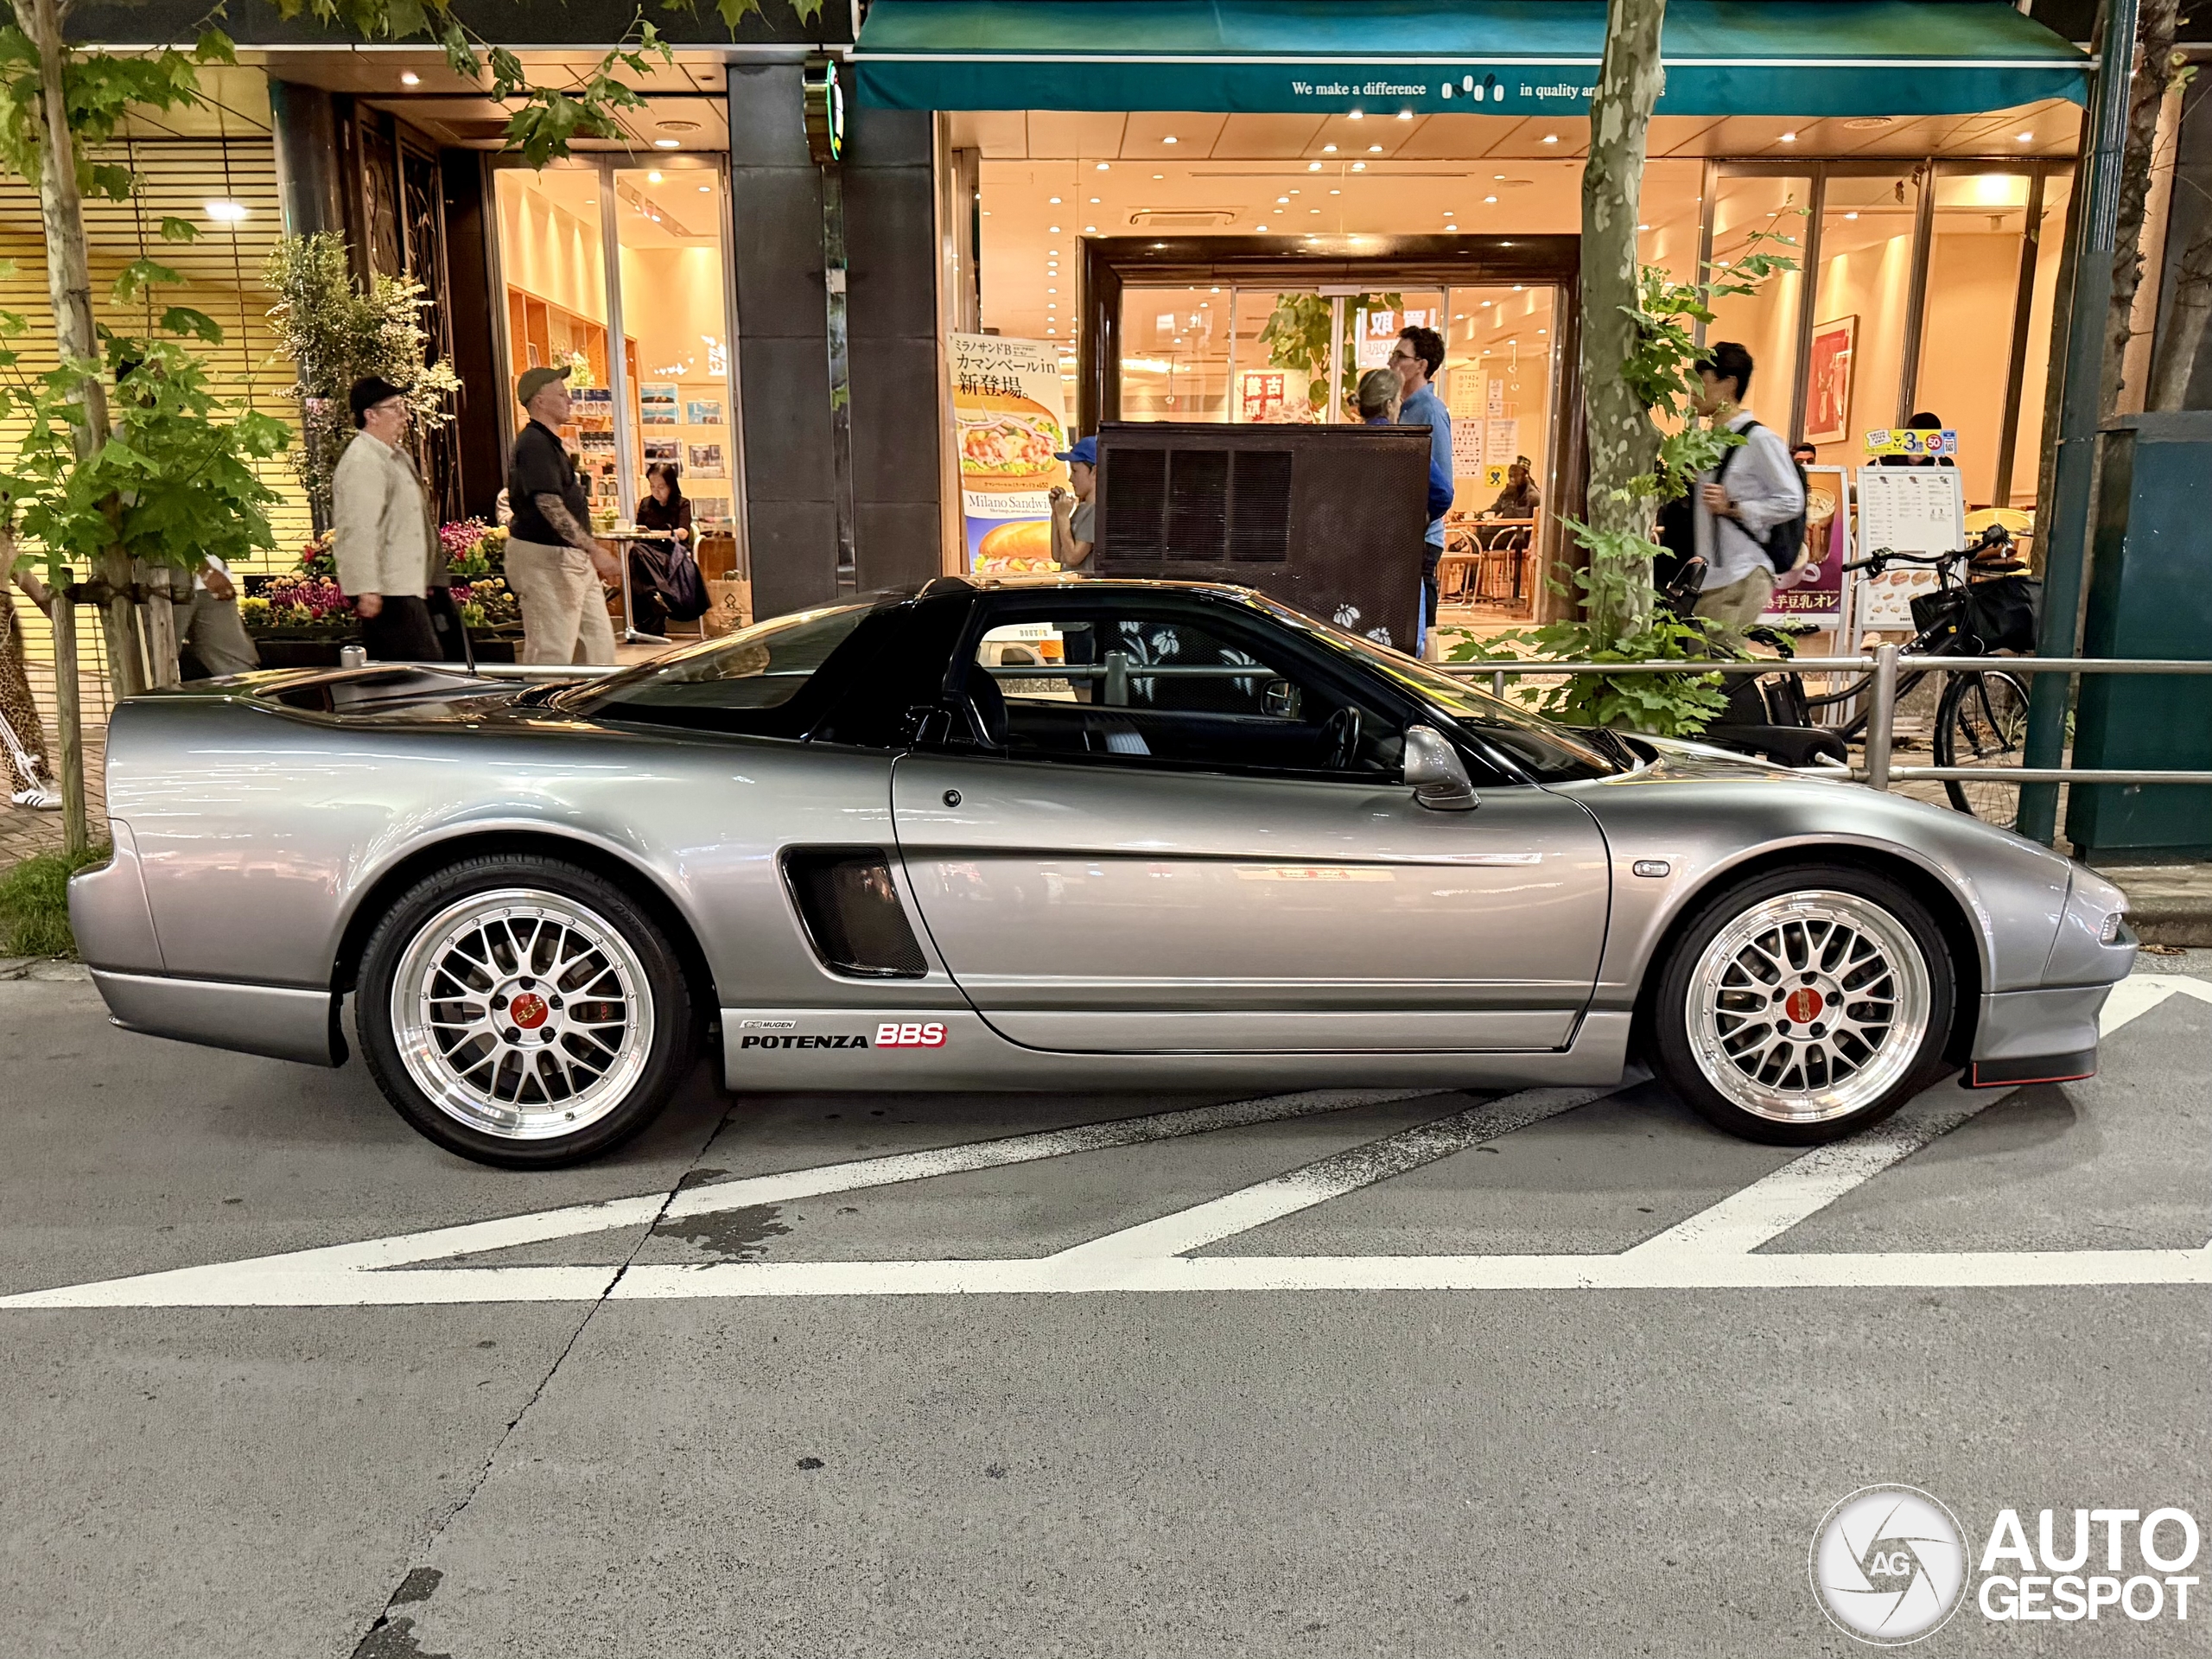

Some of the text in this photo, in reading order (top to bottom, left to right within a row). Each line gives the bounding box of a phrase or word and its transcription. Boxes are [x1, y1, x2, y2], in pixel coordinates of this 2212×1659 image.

[1292, 82, 1427, 95] We make a difference
[1520, 83, 1595, 100] in quality an
[956, 340, 1012, 355] ミラノサンドB
[957, 353, 1056, 373] カマンベールin
[958, 372, 1028, 399] 新登場。
[969, 495, 1007, 508] Milano
[741, 1035, 868, 1049] POTENZA
[874, 1022, 947, 1047] BBS
